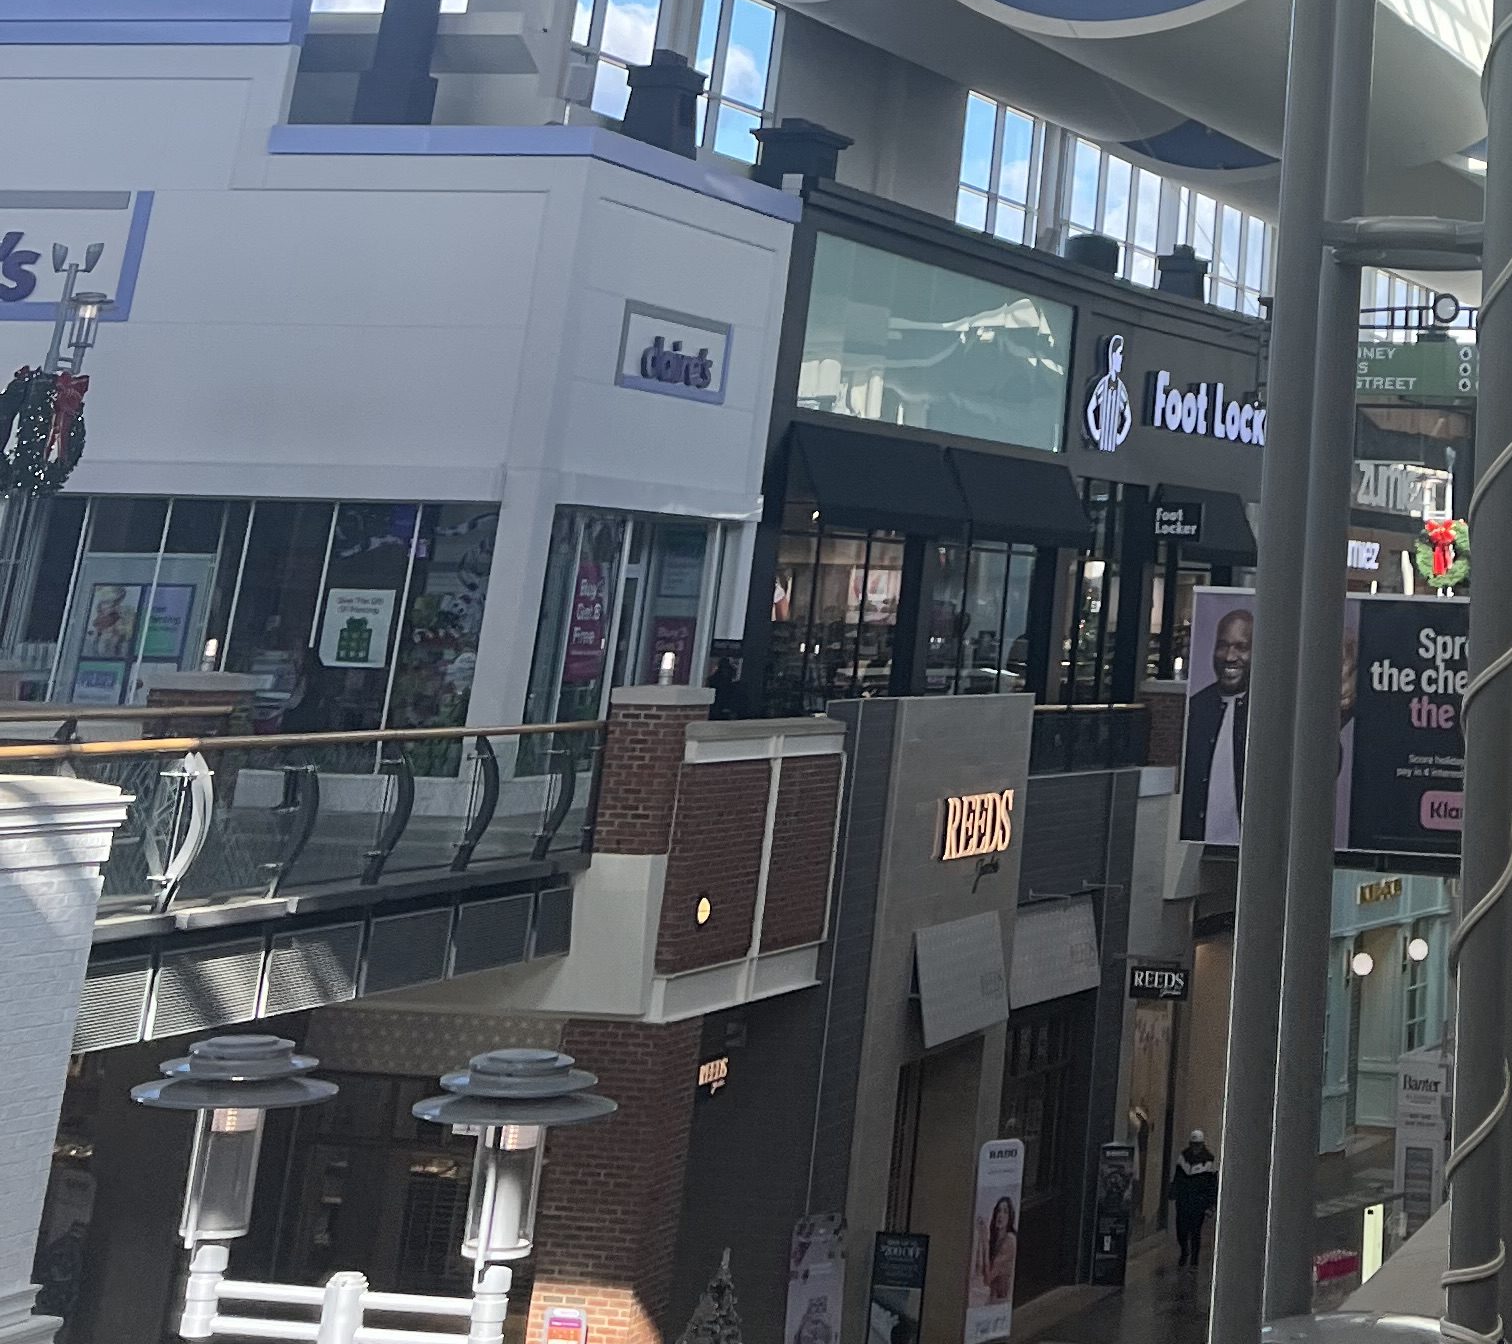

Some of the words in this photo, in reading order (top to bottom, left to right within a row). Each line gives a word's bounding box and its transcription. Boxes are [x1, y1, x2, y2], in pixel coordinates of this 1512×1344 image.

[641, 335, 713, 389] claire's
[1358, 346, 1396, 360] NEY
[1153, 370, 1208, 434] Foot
[1213, 381, 1268, 447] Lock
[1155, 507, 1185, 522] Foot
[1155, 521, 1198, 535] Locker
[1418, 627, 1469, 665] Spr
[1370, 659, 1416, 693] the
[1409, 695, 1454, 728] the
[942, 789, 1015, 861] REEDS
[1134, 970, 1185, 989] REEDS
[1402, 1074, 1441, 1093] Banter
